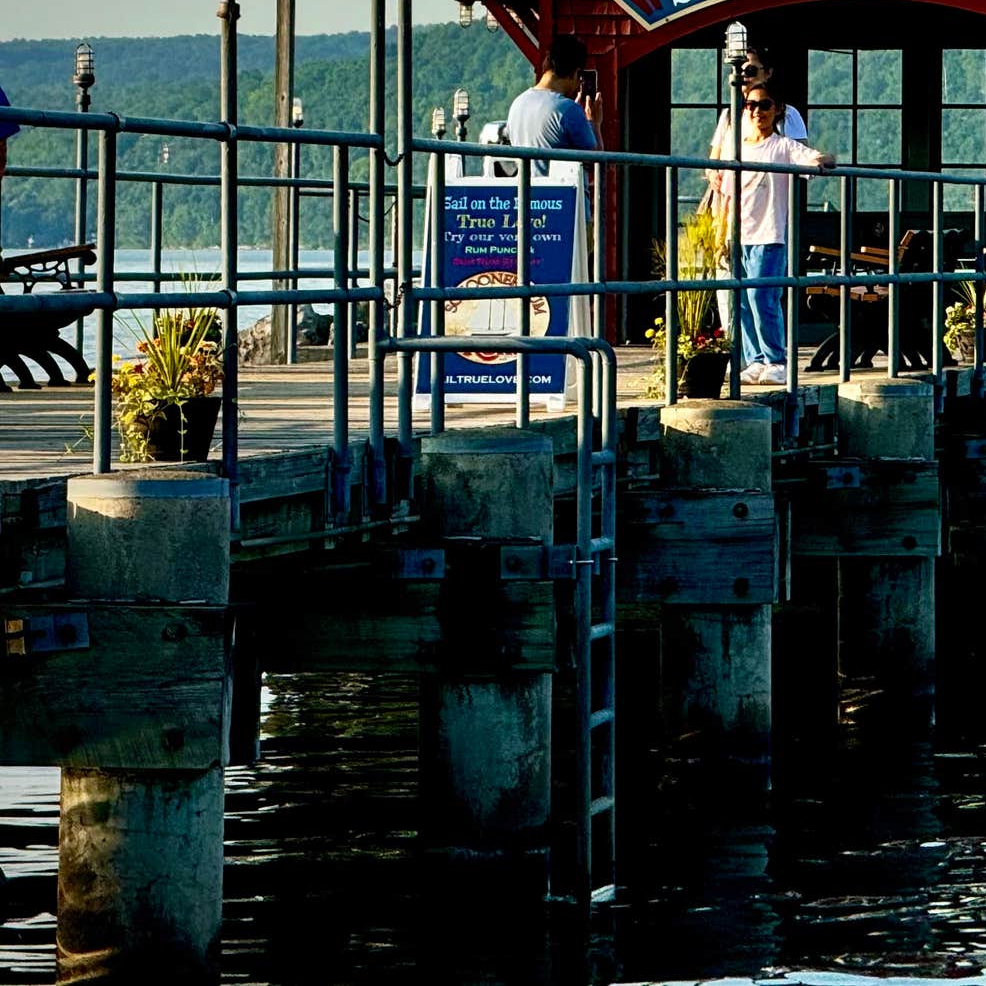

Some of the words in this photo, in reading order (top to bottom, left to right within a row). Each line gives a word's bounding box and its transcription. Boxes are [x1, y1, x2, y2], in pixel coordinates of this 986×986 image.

[444, 196, 468, 210] Sail
[470, 199, 487, 210] on
[489, 197, 511, 210] the
[513, 197, 563, 210] mous
[456, 214, 496, 228] True
[502, 214, 547, 228] Le!
[469, 233, 495, 242] our
[532, 233, 562, 242] own
[490, 245, 519, 254] PUNC
[444, 375, 552, 384] ILTRUELOVEOM
